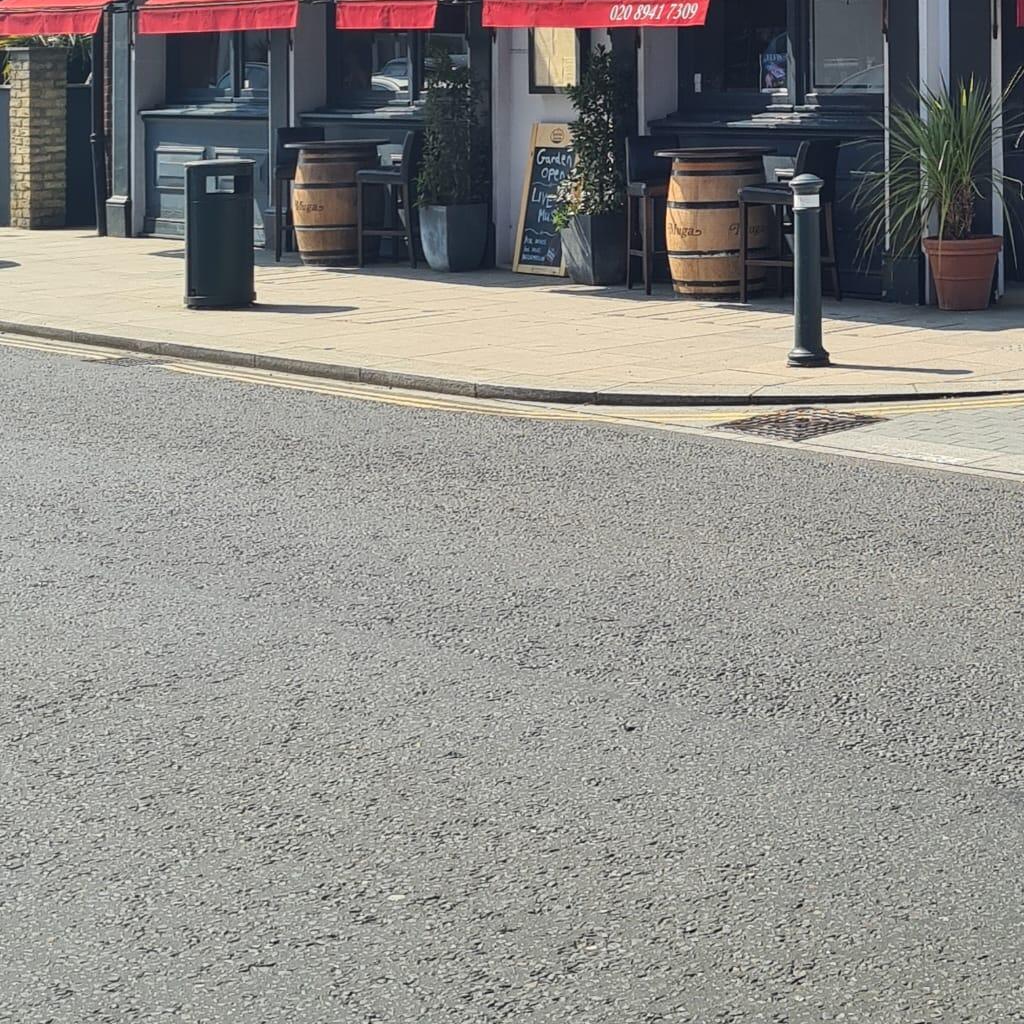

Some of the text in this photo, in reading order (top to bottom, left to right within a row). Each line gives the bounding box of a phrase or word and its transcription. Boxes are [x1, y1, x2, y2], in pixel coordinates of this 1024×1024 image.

[609, 2, 699, 21] 020 8941 7309
[536, 148, 572, 167] Garden
